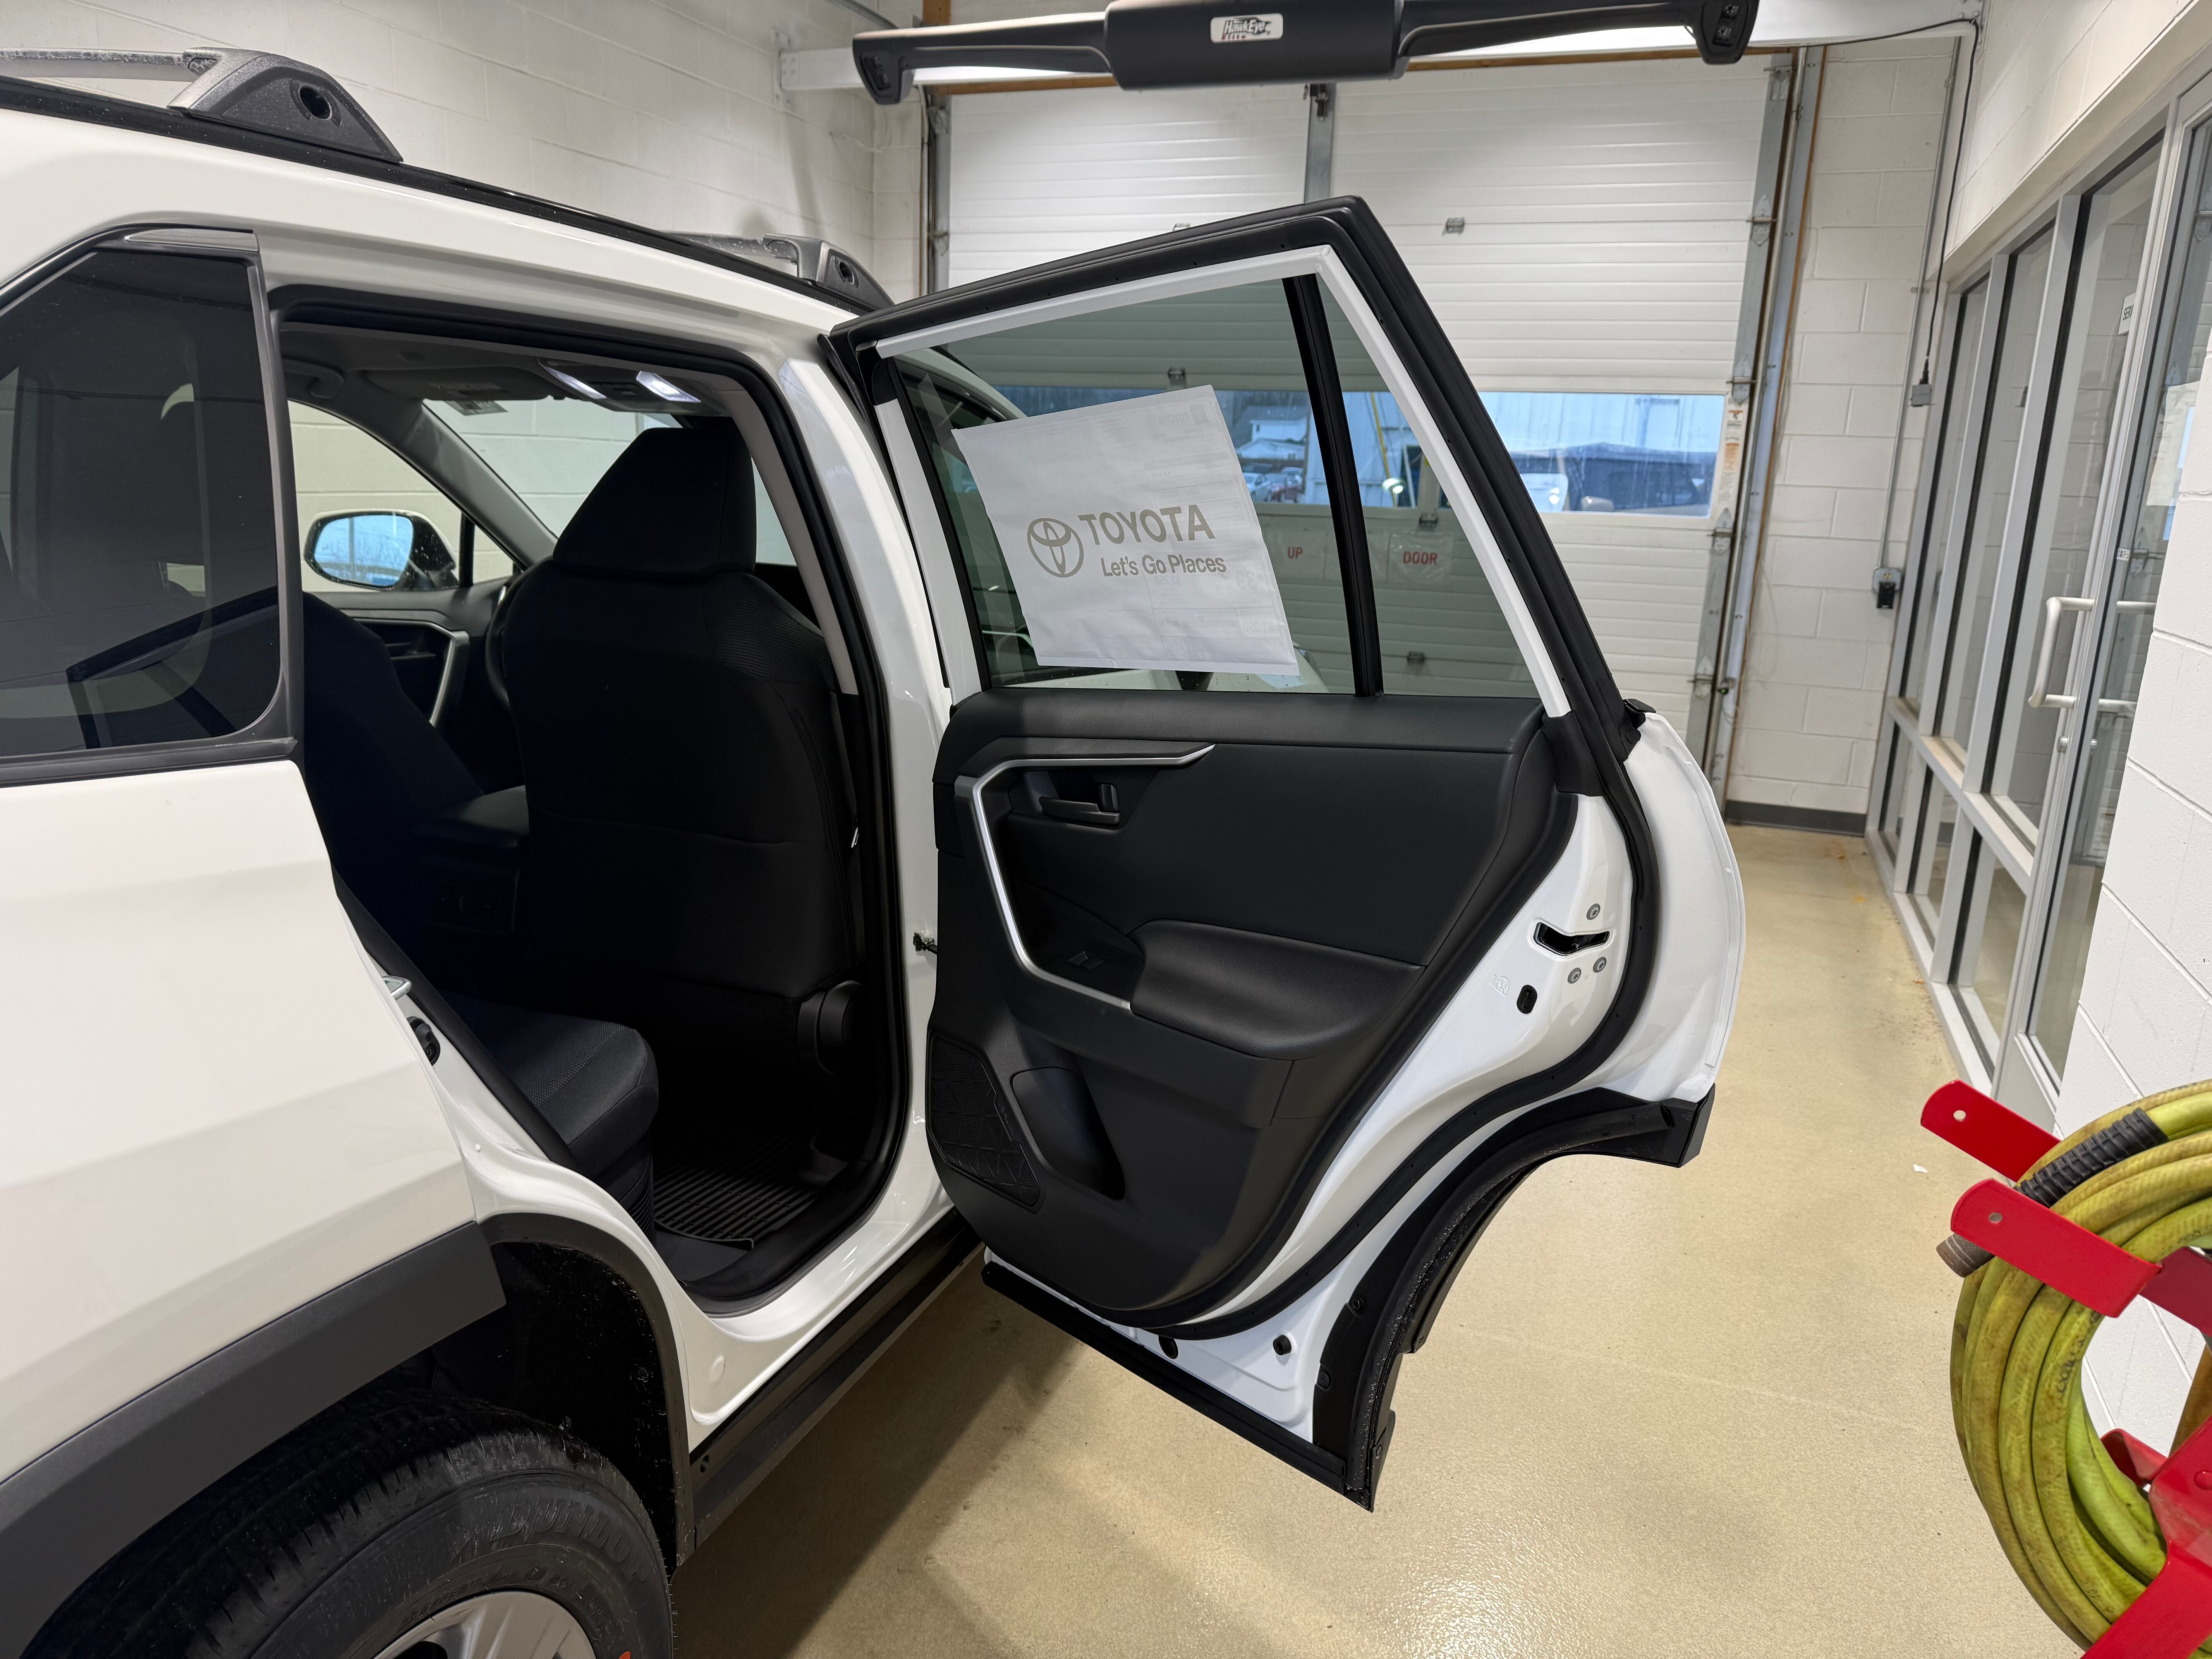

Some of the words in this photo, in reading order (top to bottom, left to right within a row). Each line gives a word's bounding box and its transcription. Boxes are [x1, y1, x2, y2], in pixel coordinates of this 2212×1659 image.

[1223, 18, 1266, 35] HawkEye
[1078, 504, 1216, 545] TOYOTA
[1287, 546, 1303, 559] UP
[1403, 551, 1438, 565] DOOR
[1101, 556, 1139, 577] Let's
[1142, 554, 1166, 574] Go
[1167, 554, 1227, 573] Places
[490, 1499, 649, 1583] DUNLOP
